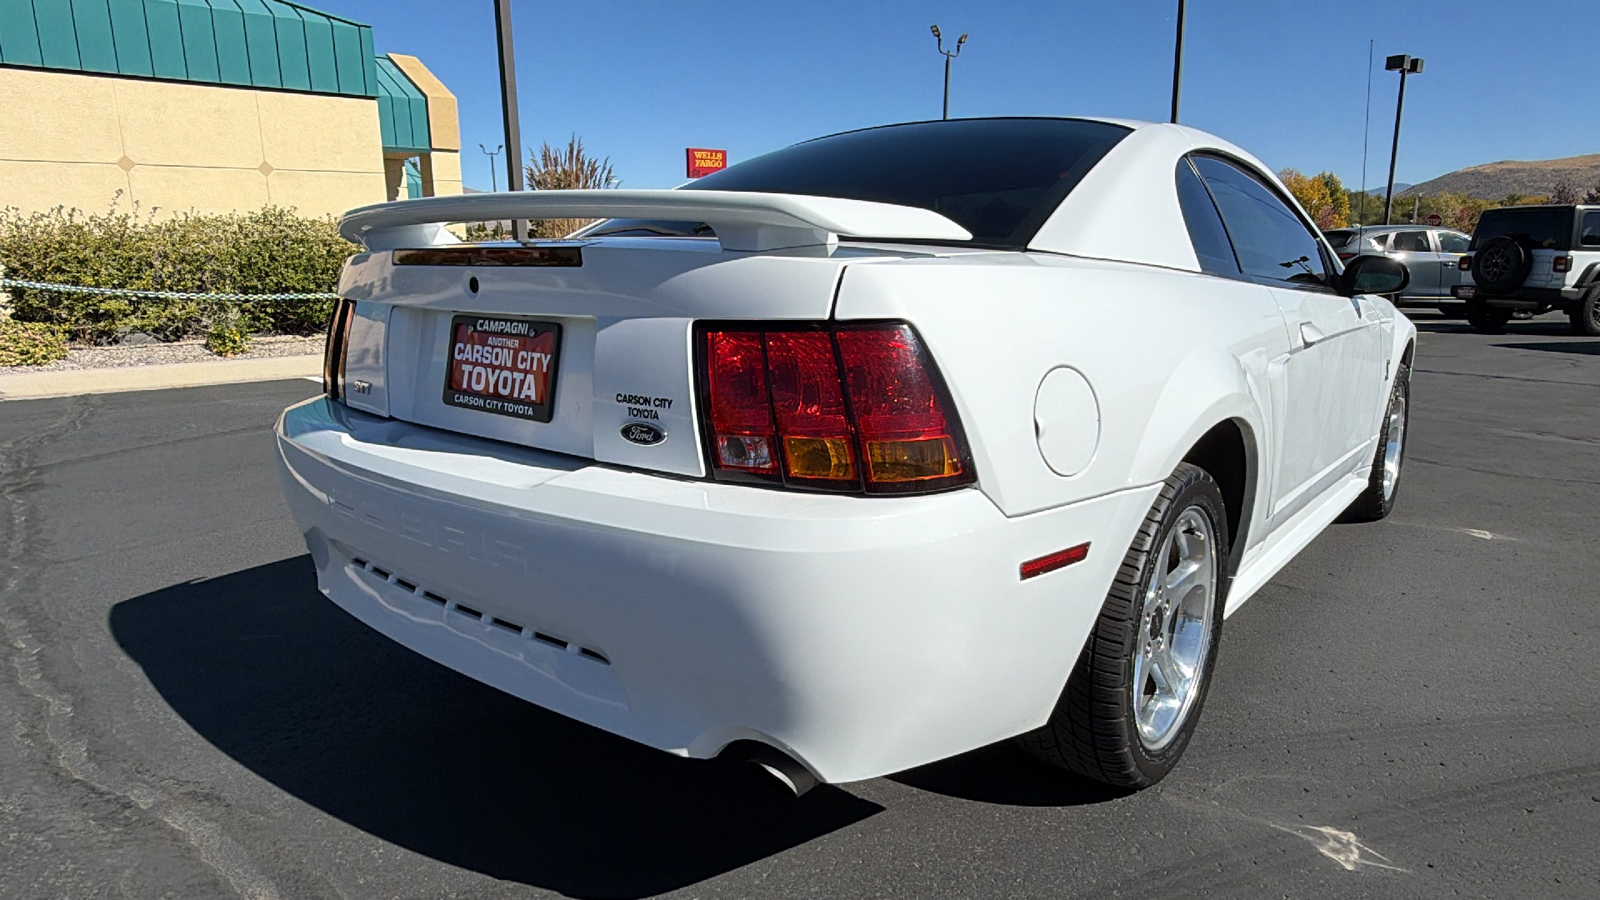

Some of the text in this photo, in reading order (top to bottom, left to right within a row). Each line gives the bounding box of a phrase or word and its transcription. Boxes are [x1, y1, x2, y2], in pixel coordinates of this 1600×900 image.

[694, 151, 722, 160] WELLS
[695, 159, 722, 168] FARGO
[476, 319, 529, 335] CAMPAGNI
[487, 336, 519, 348] ANOTHER
[454, 342, 551, 372] CARSON CITY
[461, 364, 536, 401] TOYOTA
[454, 394, 534, 416] CARSON CITY TOYOTA
[616, 393, 673, 409] CARSON CITY
[628, 406, 660, 420] TOYOTA
[629, 426, 654, 441] Ford
